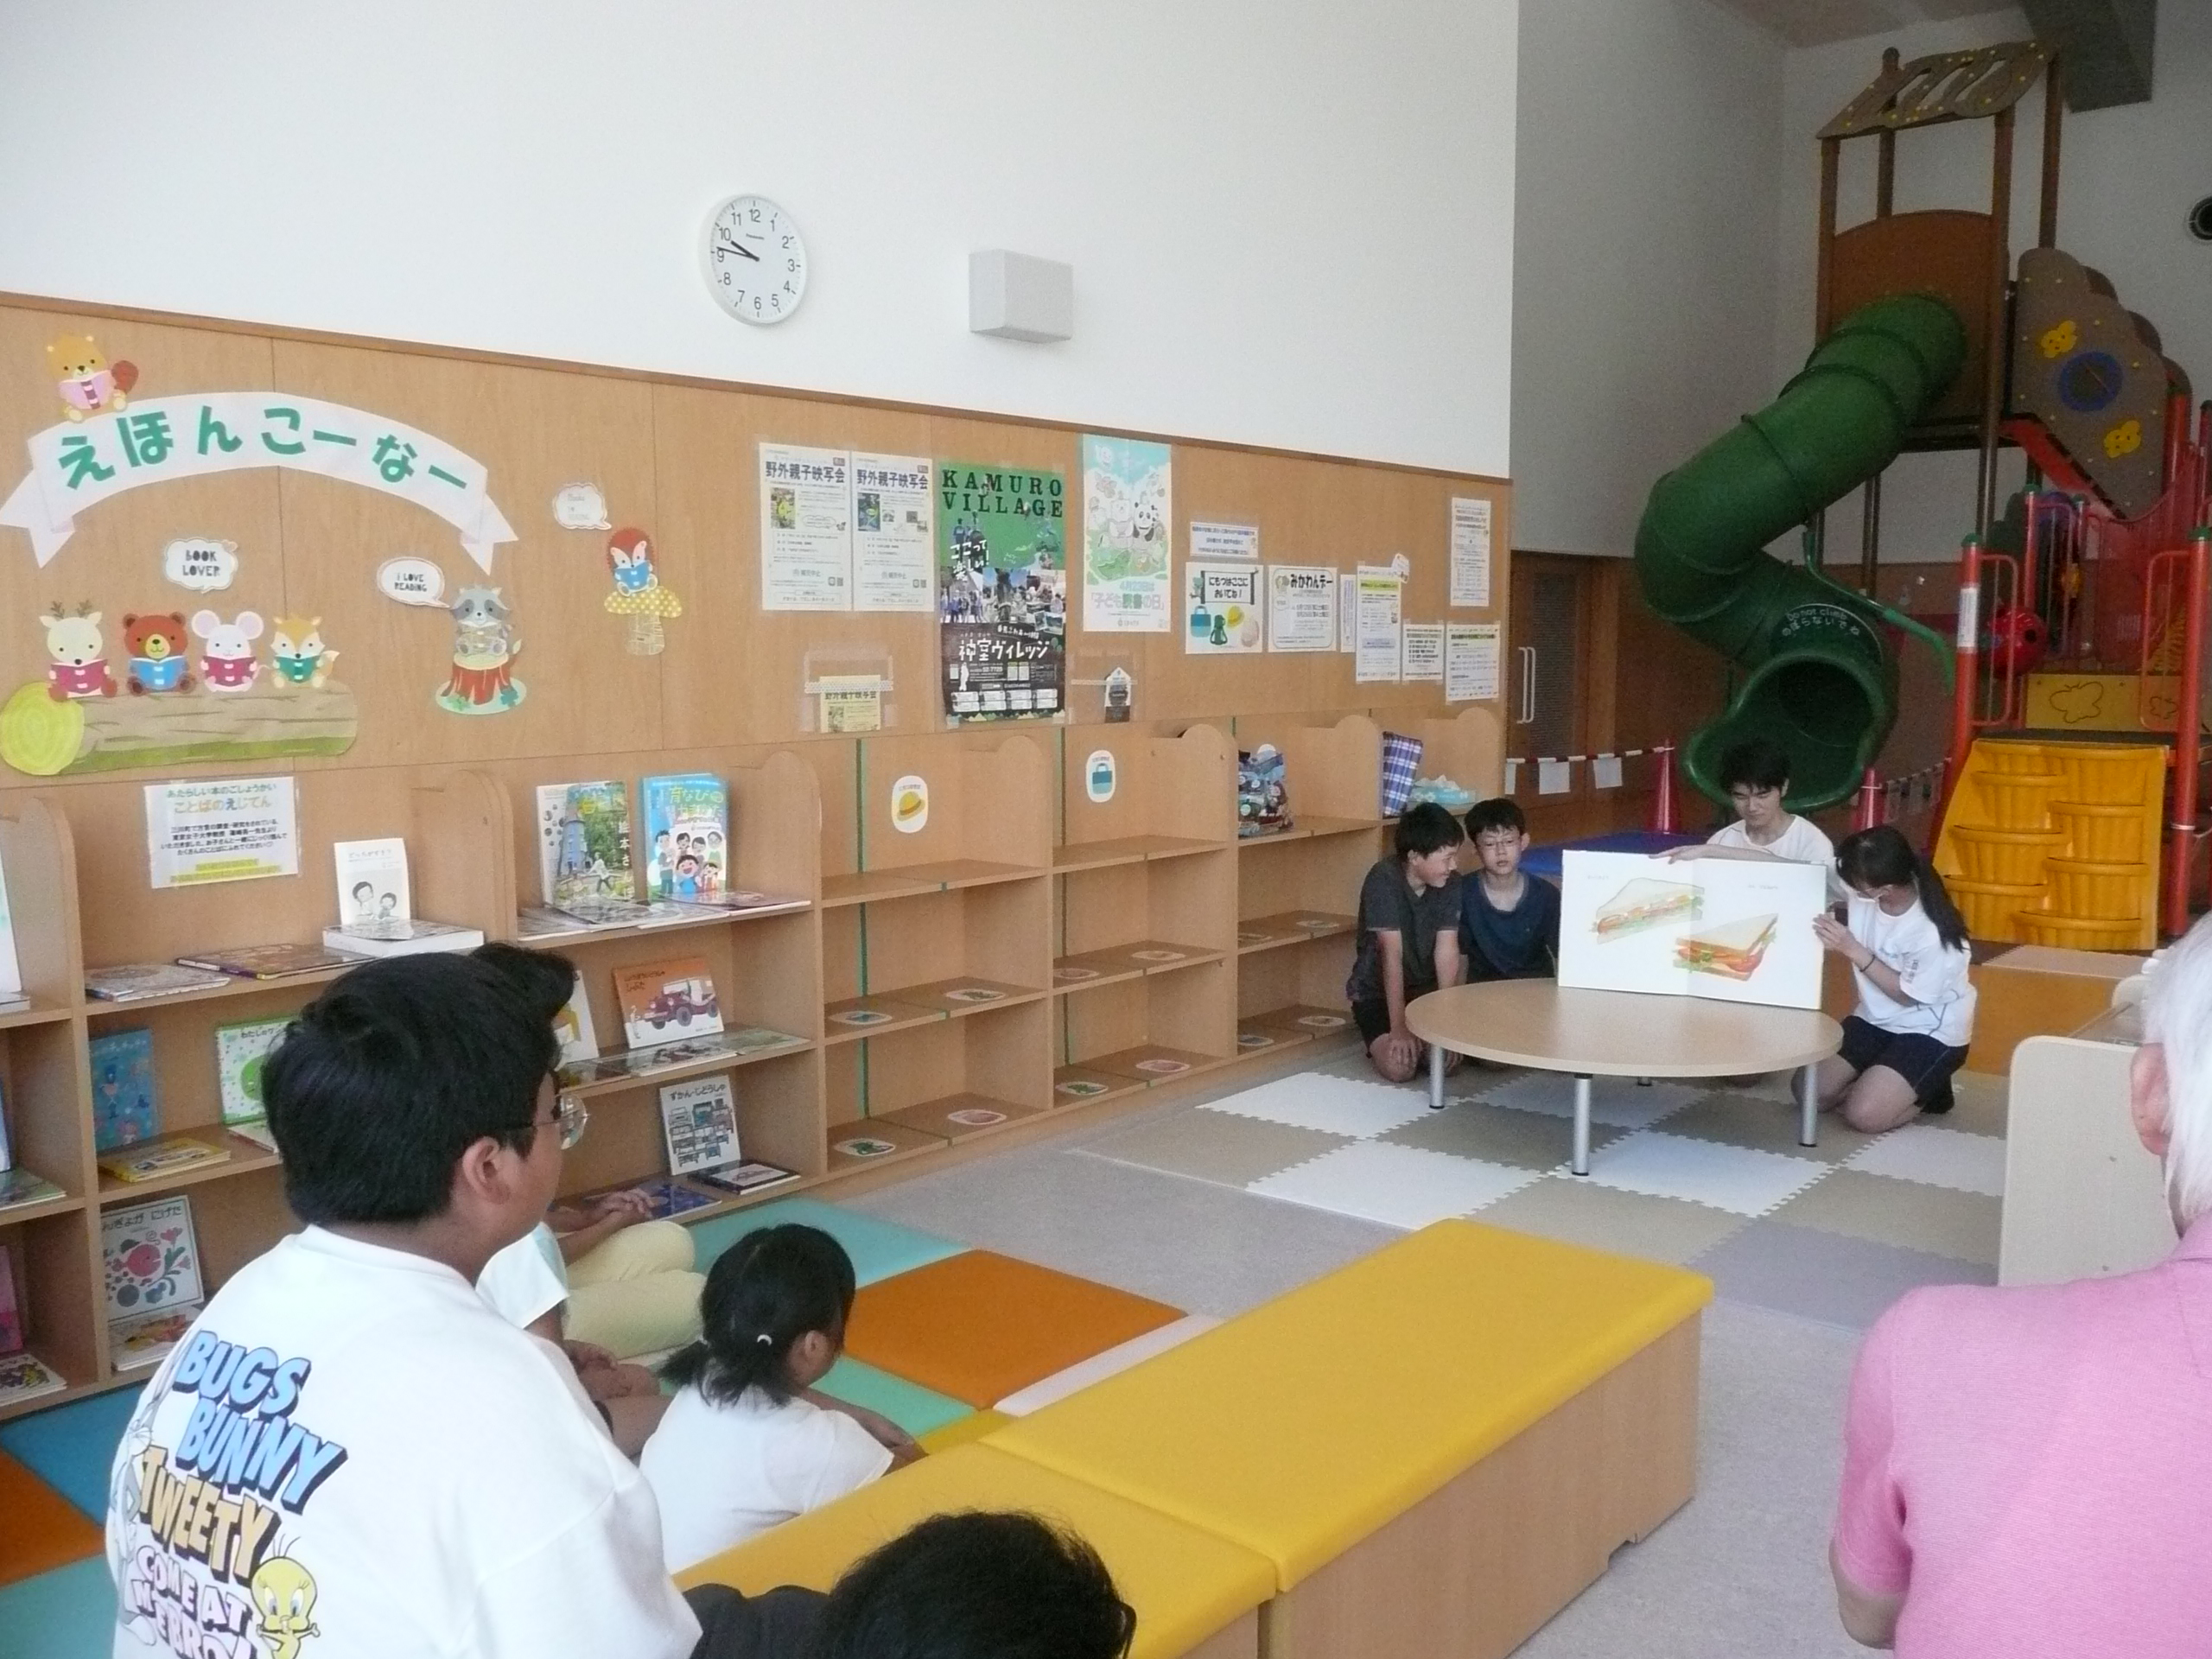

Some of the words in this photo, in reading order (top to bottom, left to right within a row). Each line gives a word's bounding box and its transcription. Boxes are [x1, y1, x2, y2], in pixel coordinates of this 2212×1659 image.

[731, 212, 741, 226] 11
[748, 208, 761, 223] 12
[770, 219, 775, 232] 1
[719, 227, 731, 241] 10
[782, 236, 790, 249] 2
[716, 248, 725, 263] 9
[787, 258, 795, 272] 3
[723, 272, 732, 285] 8
[783, 280, 791, 293] 4
[737, 289, 745, 303] 7
[754, 296, 762, 309] 6
[771, 294, 779, 307] 5
[58, 406, 467, 489] えほんこーなー
[766, 461, 845, 484] 野外親子映写会
[857, 468, 928, 490] 野外親子映写会
[942, 469, 1062, 497] KAMURO
[942, 492, 1063, 518] VILLAGE
[186, 550, 217, 562] BOOK
[182, 564, 220, 576] LOVER
[404, 573, 423, 582] LOVE
[1209, 576, 1249, 587] にもつはここに
[1290, 574, 1333, 588] みかわんデー
[1787, 612, 1800, 621] Do
[1820, 608, 1847, 620] climb
[1782, 617, 1859, 636] のぼらないでね
[959, 638, 1050, 662] 神室ヴィレッジ
[151, 1205, 181, 1220] にげた
[173, 1330, 311, 1418] BUGS
[175, 1397, 348, 1516] BUNNY
[140, 1445, 282, 1588] TWEETY
[137, 1545, 198, 1621] COME
[201, 1585, 253, 1637] AT
